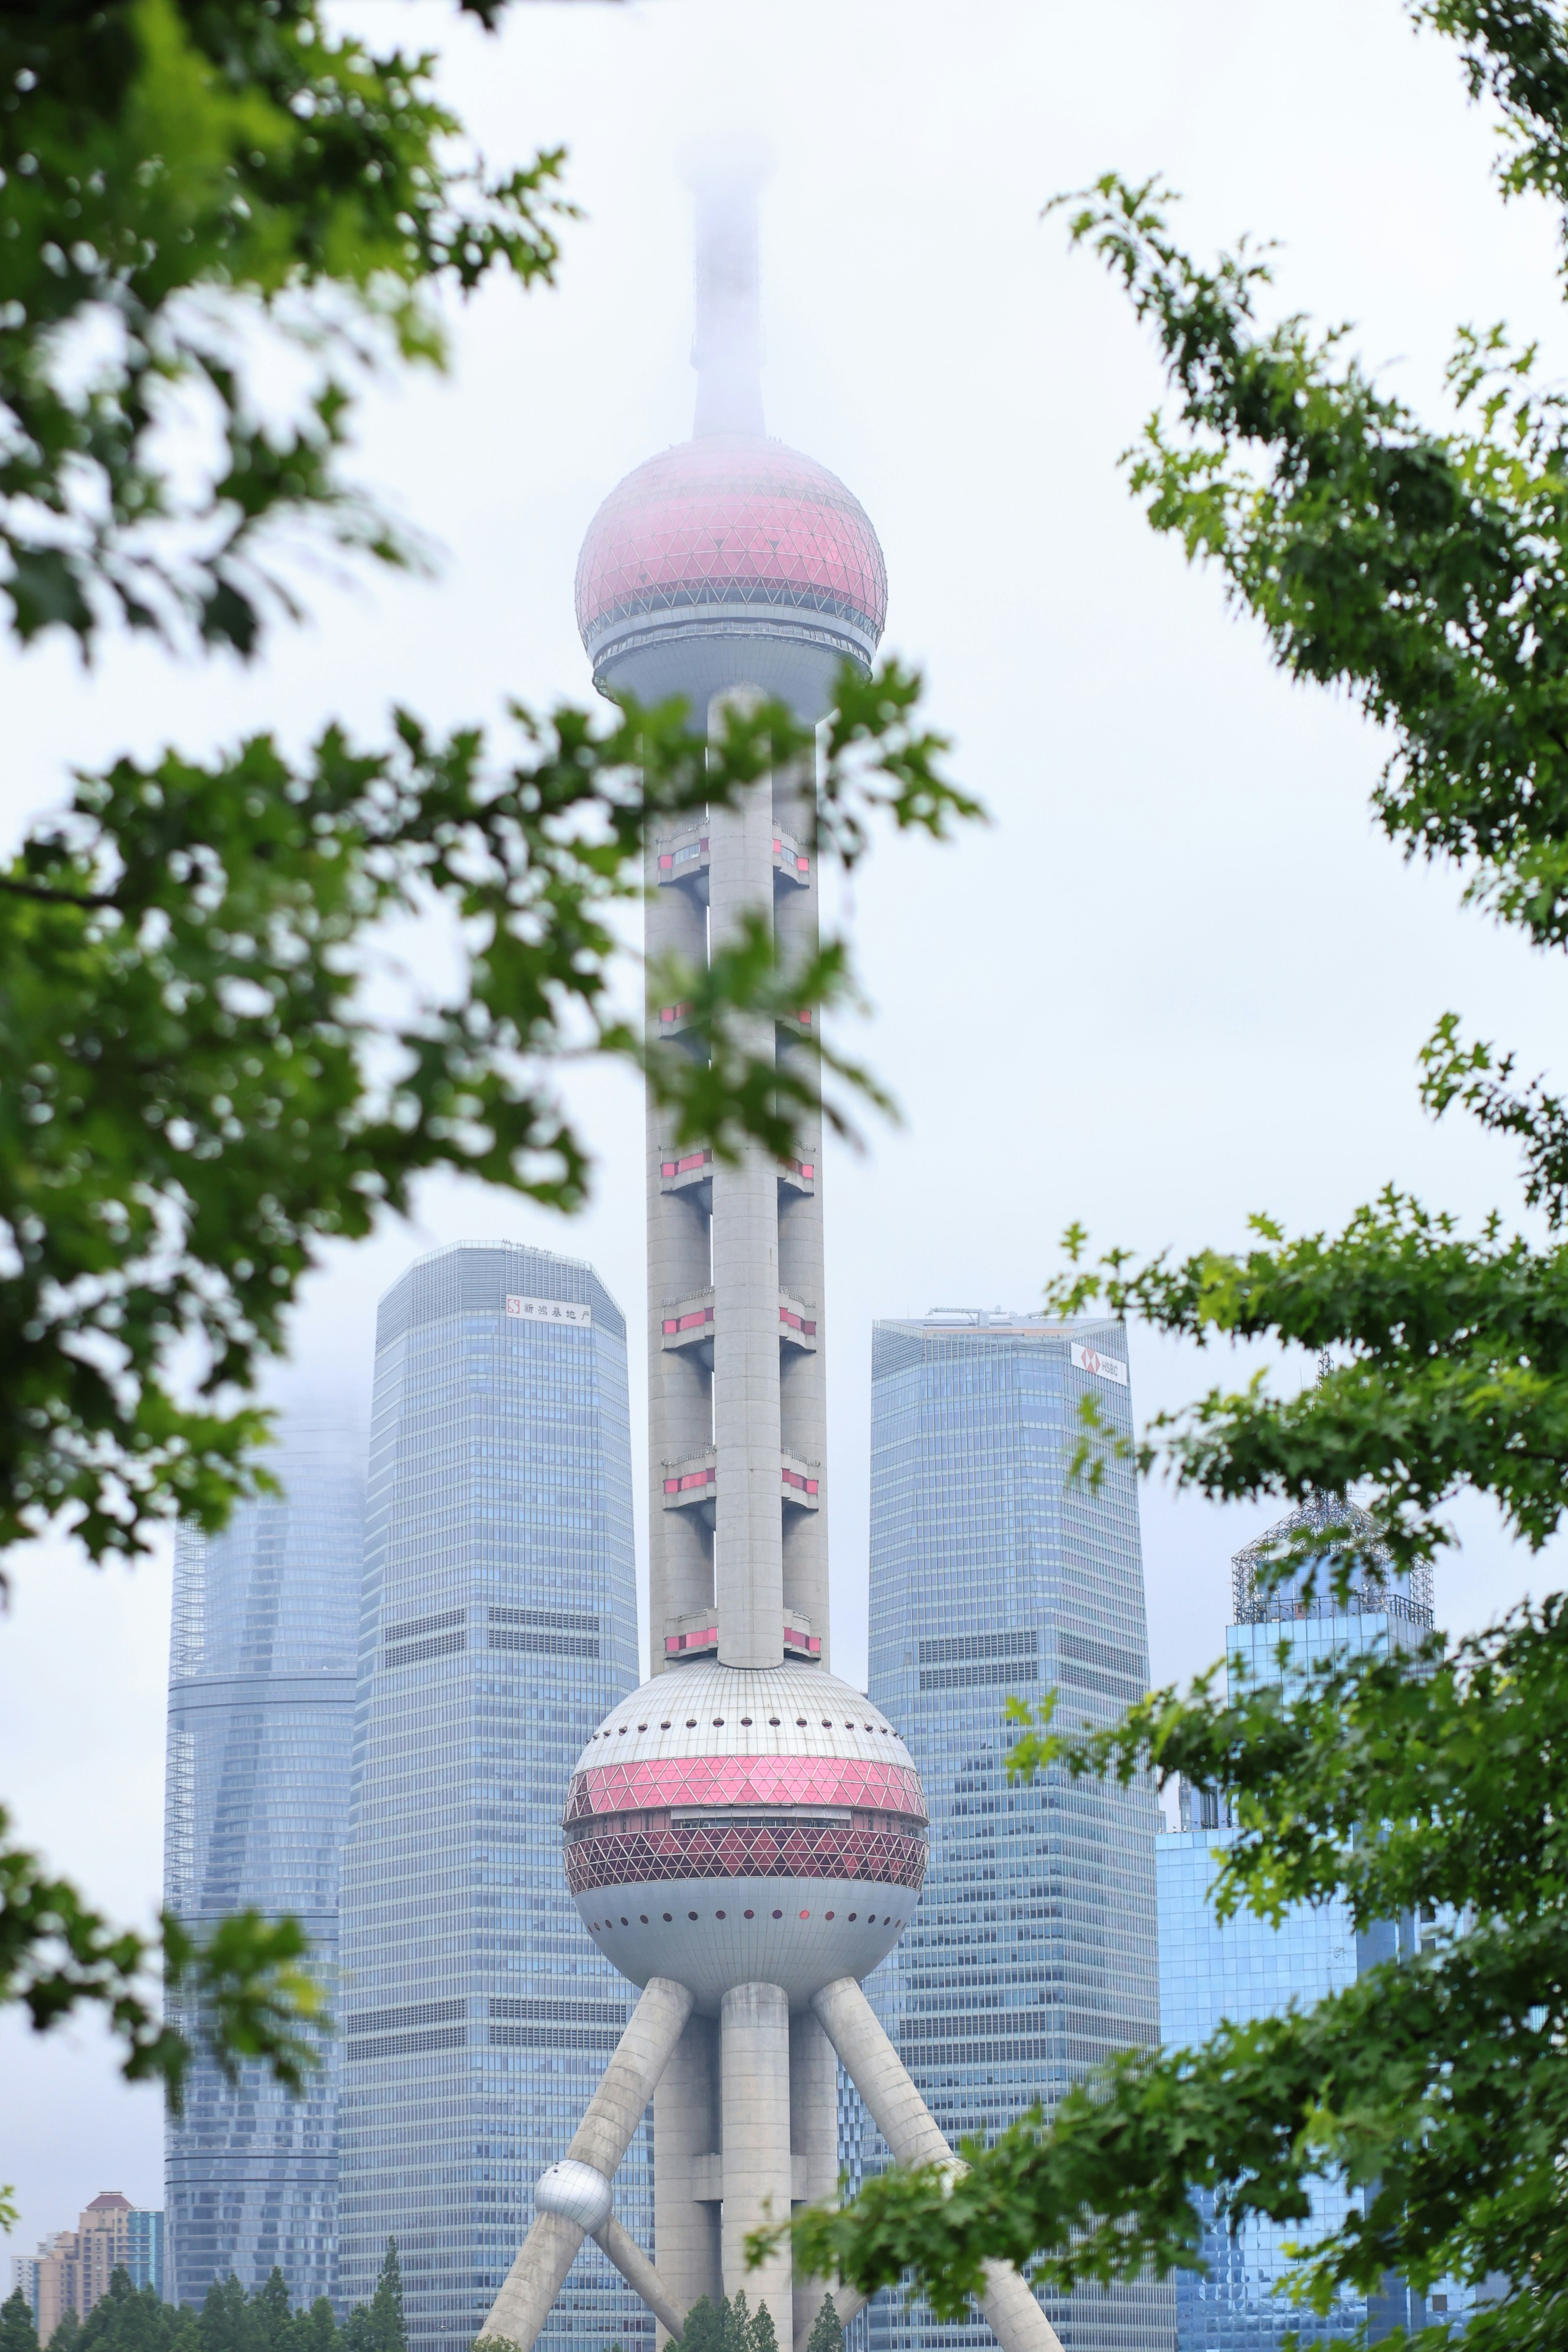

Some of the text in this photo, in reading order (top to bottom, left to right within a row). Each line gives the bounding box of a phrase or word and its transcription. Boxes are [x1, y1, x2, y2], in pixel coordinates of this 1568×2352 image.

[524, 1304, 590, 1321] 新鸿基地产
[1102, 1361, 1118, 1376] HSBC
